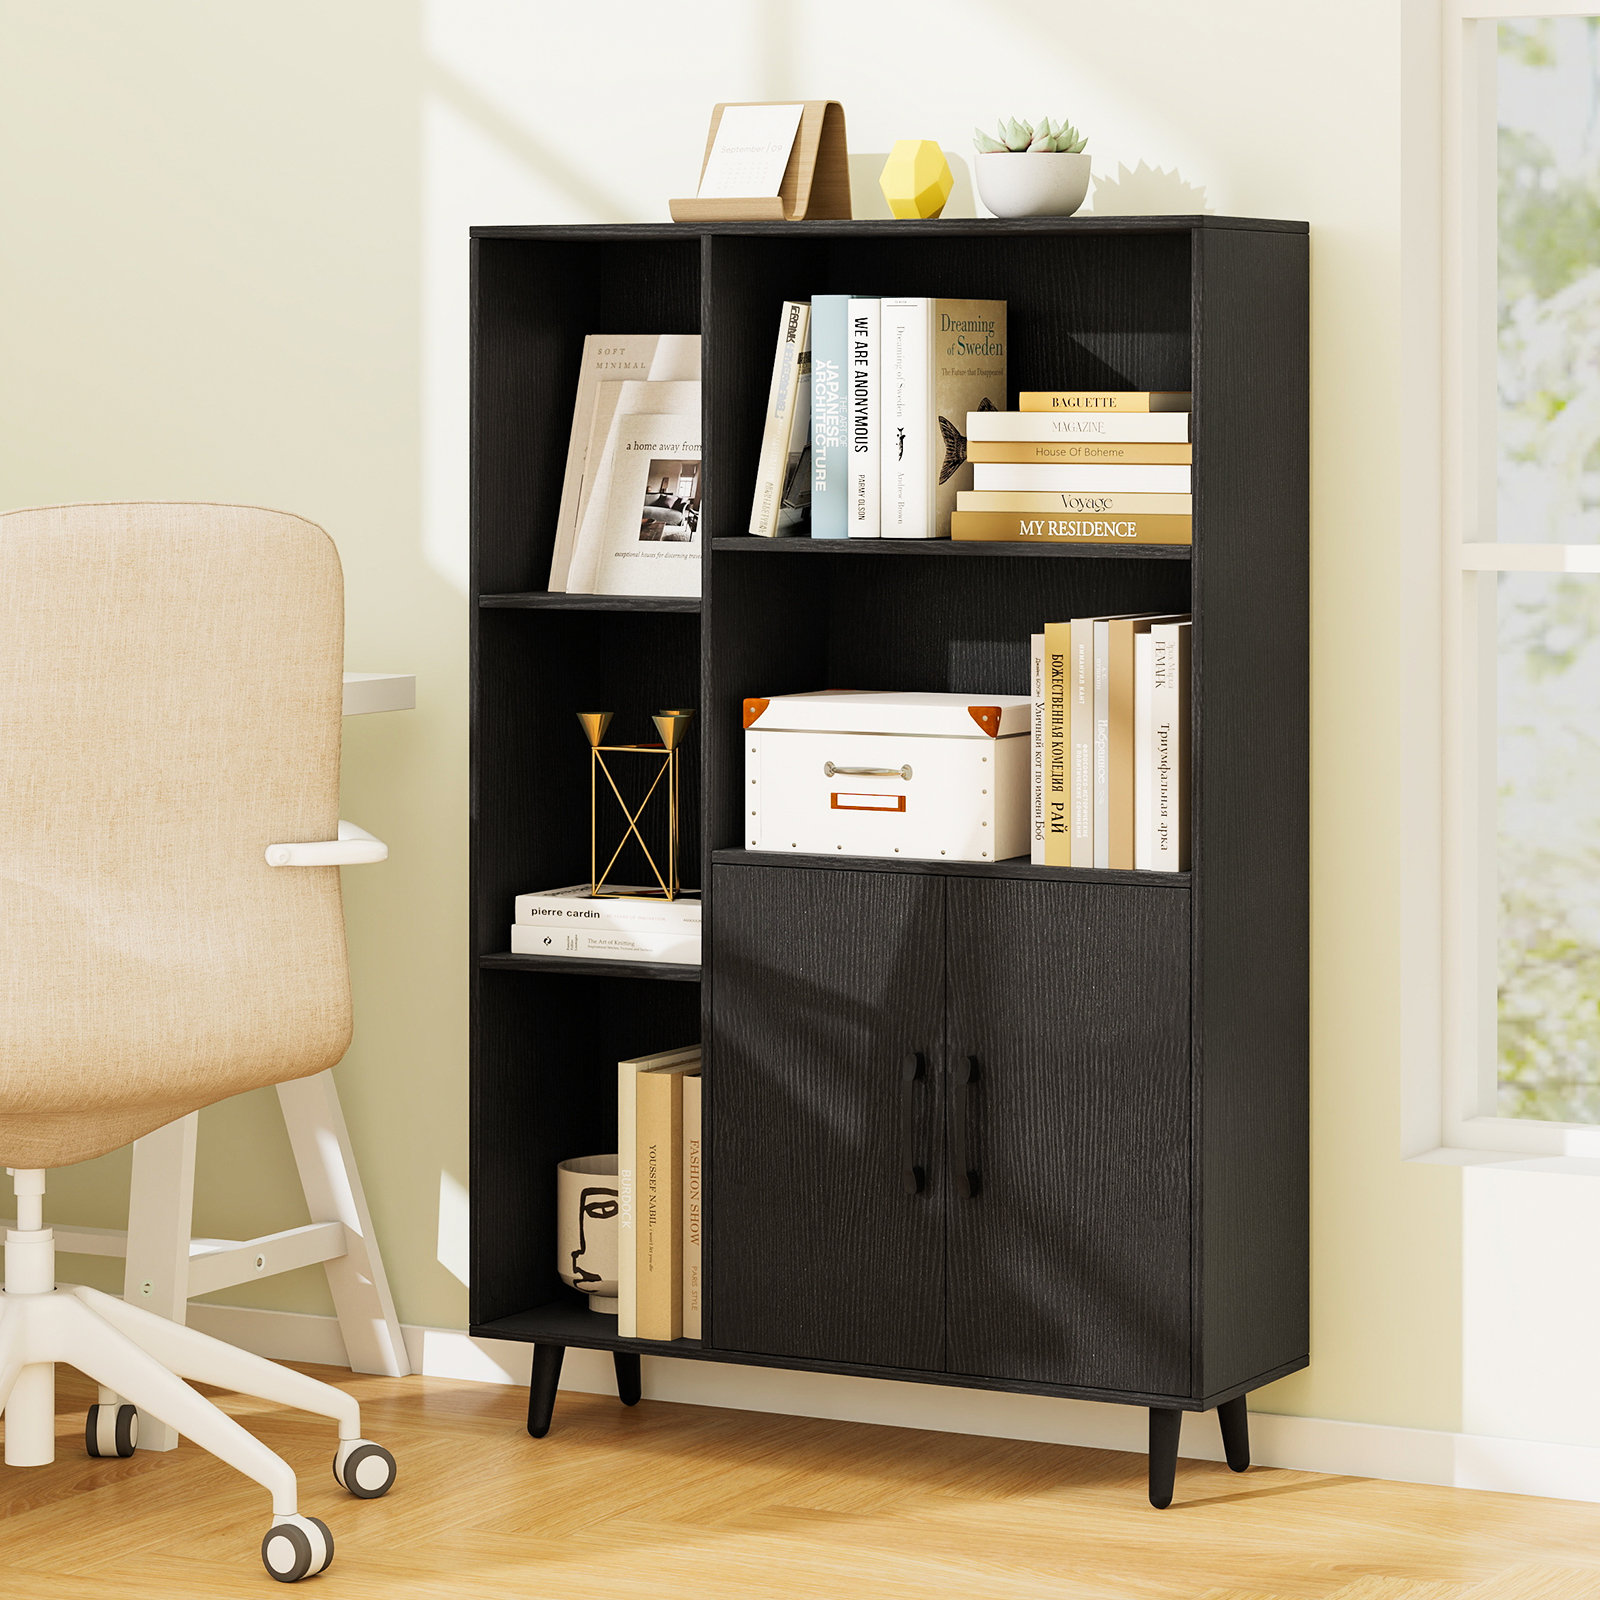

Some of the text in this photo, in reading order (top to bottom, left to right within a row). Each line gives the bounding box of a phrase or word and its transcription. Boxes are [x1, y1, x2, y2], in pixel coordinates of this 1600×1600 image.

[720, 144, 766, 154] September
[941, 313, 995, 338] Dreaming
[597, 348, 627, 356] SOFT
[947, 335, 1003, 356] of Sweden
[595, 362, 648, 370] MINIMAL
[855, 317, 868, 453] WE ARE ANONYMOUS
[826, 360, 840, 448] JAPANESE
[1052, 397, 1117, 409] BAGUETTE
[815, 360, 826, 491] ARCHITECTURE
[840, 395, 848, 448] THE ART OF
[1052, 421, 1106, 434] MAGAZINE
[626, 443, 632, 451] a
[633, 441, 657, 451] home
[659, 444, 680, 454] away
[1035, 447, 1125, 457] House Of Boheme
[858, 474, 866, 521] PARMY OLSON
[1061, 494, 1113, 512] Voyage
[1019, 520, 1138, 537] MY RESIDENCE
[1050, 654, 1068, 834] БОЖЕСТВЕННАЯ КОМЕДИЯ РАЙ
[1034, 703, 1046, 841] Уличный кот по имени Боб
[1158, 723, 1171, 851] Триумфальная арка
[531, 907, 563, 916] pierre
[566, 910, 600, 918] cardin
[649, 1144, 657, 1193] YOUSSEF
[621, 1169, 632, 1230] BURDOCK
[690, 1139, 700, 1247] FASHION SHOW
